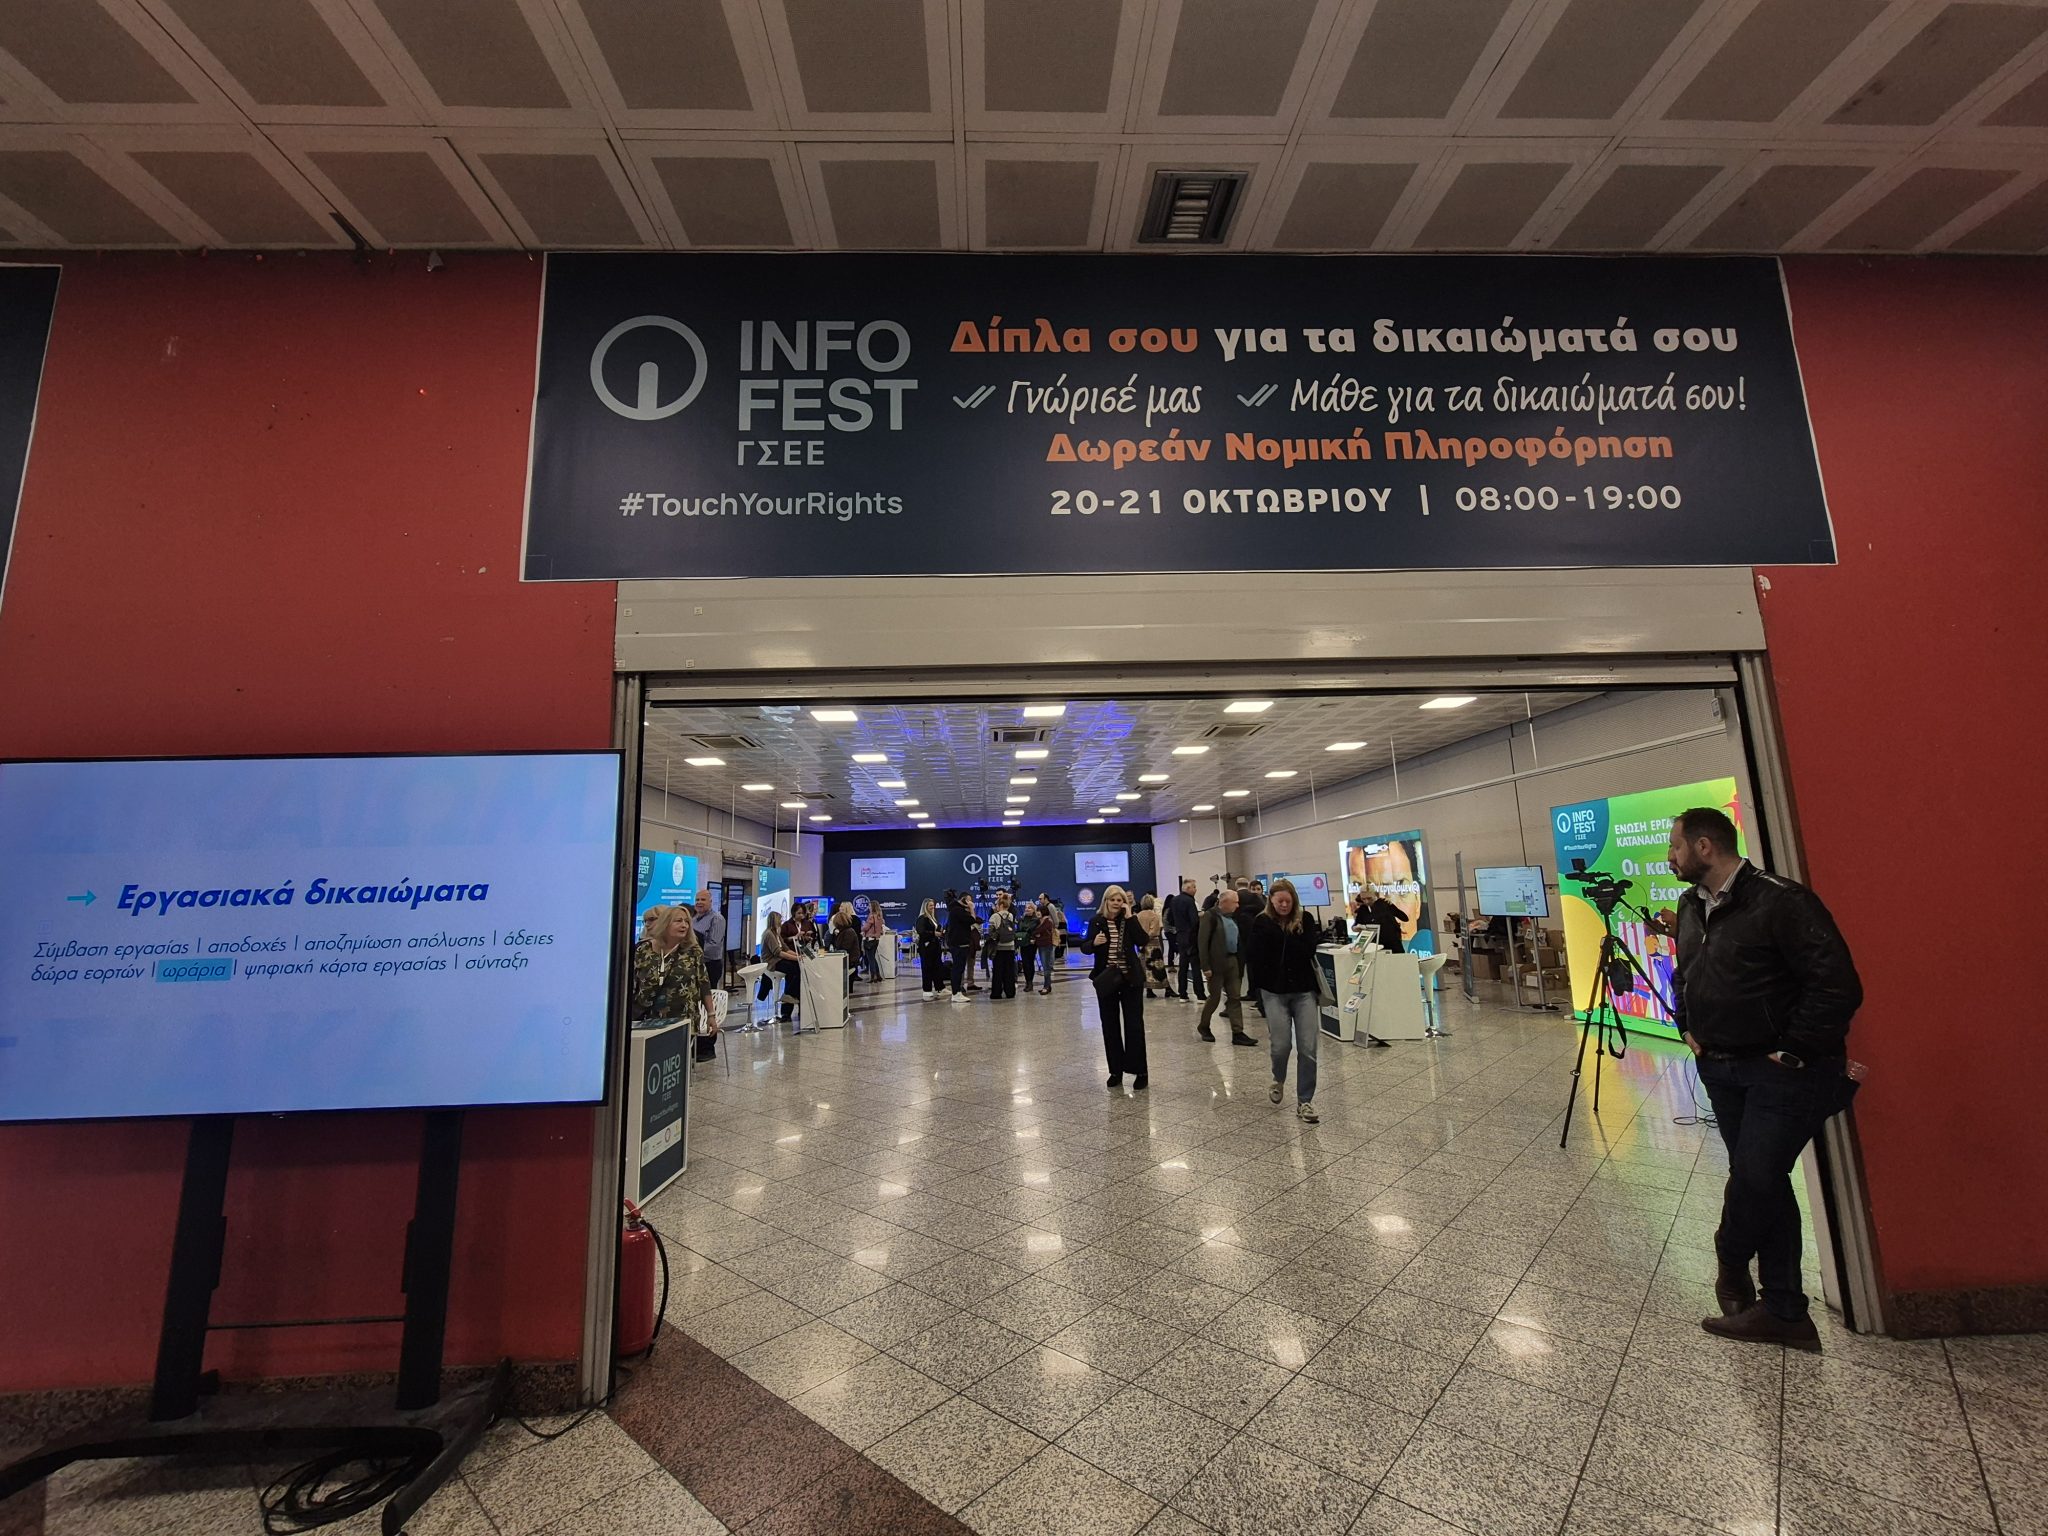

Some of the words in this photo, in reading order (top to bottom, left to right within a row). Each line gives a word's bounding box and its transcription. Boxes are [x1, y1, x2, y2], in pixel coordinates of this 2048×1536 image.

[739, 319, 911, 372] INFO
[949, 315, 1092, 354] Δίπλα
[1108, 327, 1198, 353] σου
[1213, 327, 1288, 362] για
[1302, 327, 1356, 353] τα
[1372, 315, 1638, 362] δικαιώματά
[1652, 327, 1739, 353] σου
[738, 378, 918, 432] FEST
[1006, 373, 1140, 426] Γνώρισέ
[1144, 385, 1203, 428] μας
[1289, 372, 1379, 414] Μάθε
[1387, 385, 1436, 424] για
[1443, 385, 1484, 413] τα
[1492, 371, 1677, 426] δικαιώματά
[1684, 375, 1747, 412] σου!
[737, 440, 826, 467] ΓΣΕΕ
[1046, 428, 1212, 471] Δωρεάν
[1225, 427, 1372, 469] Νομική
[1384, 426, 1674, 468] Πληροφόρηση
[618, 491, 903, 522] #TouchYourRights
[1050, 488, 1161, 516] 20-21
[1182, 486, 1393, 515] ΟΚΤΩΒΡΙΟΥ
[1455, 484, 1682, 513] 08:00-19:00
[1572, 809, 1594, 823] INFO
[1574, 821, 1596, 834] FEST
[1614, 822, 1647, 835] ΕΝΩΣΗ
[987, 853, 1018, 865] INFO
[987, 864, 1019, 876] FEST
[1621, 858, 1641, 876] Οι
[116, 884, 293, 917] Εργασιακά
[304, 876, 490, 911] δικαιώματα
[33, 940, 108, 961] Σύμβαση
[113, 938, 189, 961] εργασίας
[207, 936, 287, 955] αποδοχές
[304, 933, 401, 955] αποζημίωση
[407, 930, 486, 950] απόλυσης
[503, 928, 555, 947] άδειες
[31, 963, 79, 984] δώρα
[83, 964, 145, 984] εορτών
[162, 962, 226, 980] ωράρια
[244, 958, 314, 981] ψηφιακή
[319, 957, 368, 978] κάρτα
[372, 954, 448, 977] εργασίας
[465, 951, 529, 973] σύνταξη
[662, 1054, 681, 1076] INFO
[661, 1069, 681, 1093] FEST
